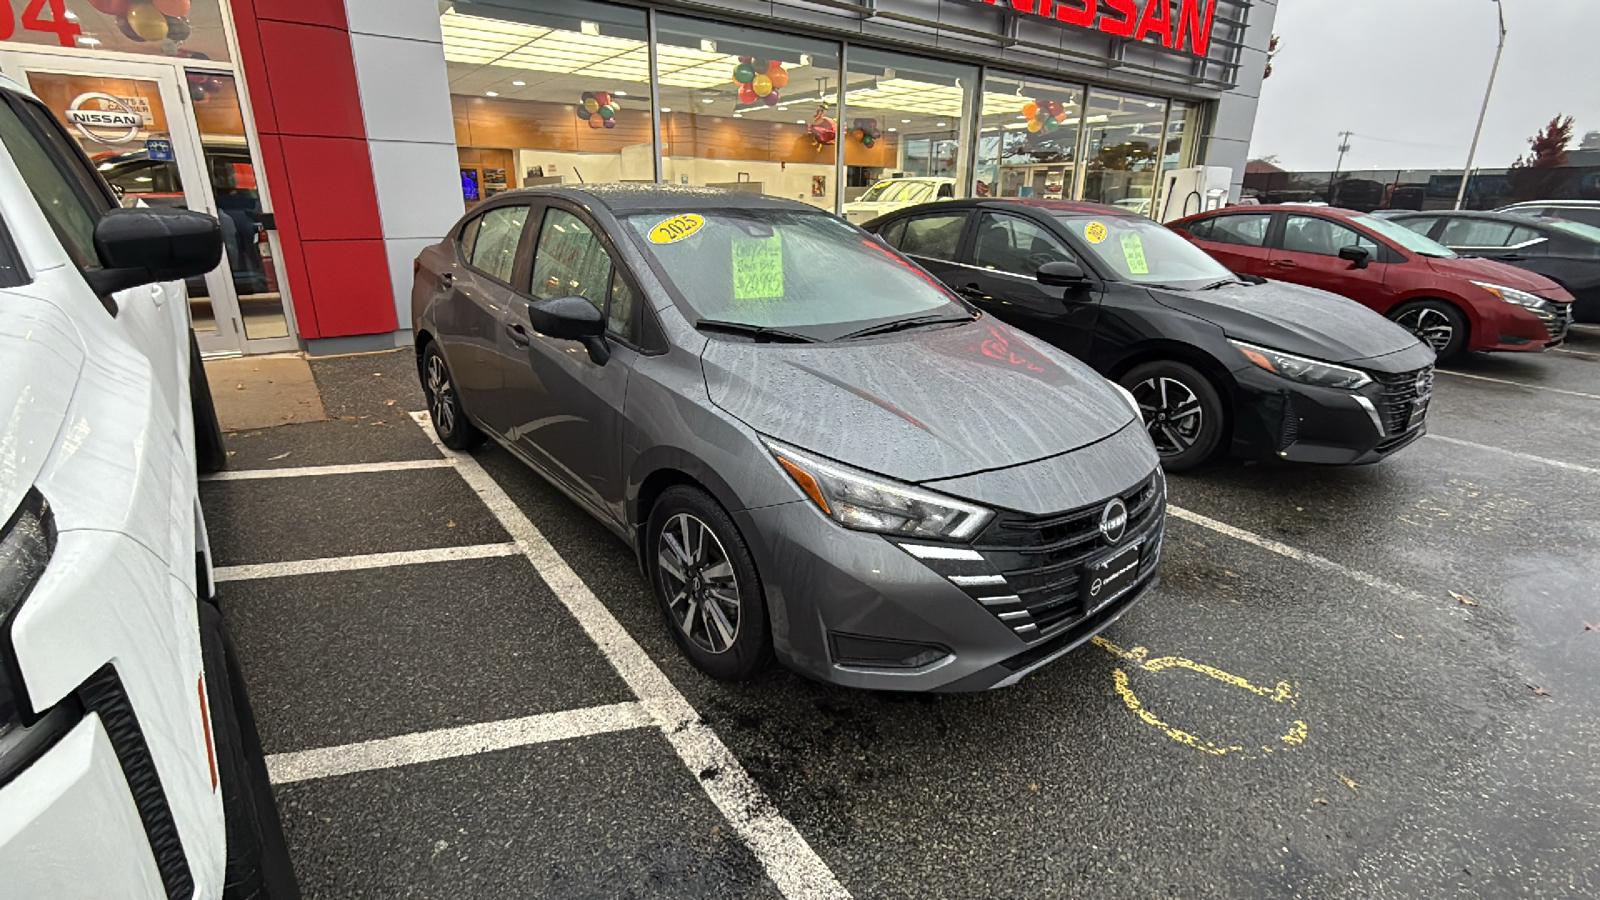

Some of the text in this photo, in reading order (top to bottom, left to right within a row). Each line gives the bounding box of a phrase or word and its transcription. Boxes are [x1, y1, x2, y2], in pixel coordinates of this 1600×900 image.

[984, 0, 1215, 56] SAN
[73, 113, 136, 125] NISSAN
[659, 215, 698, 240] 2025
